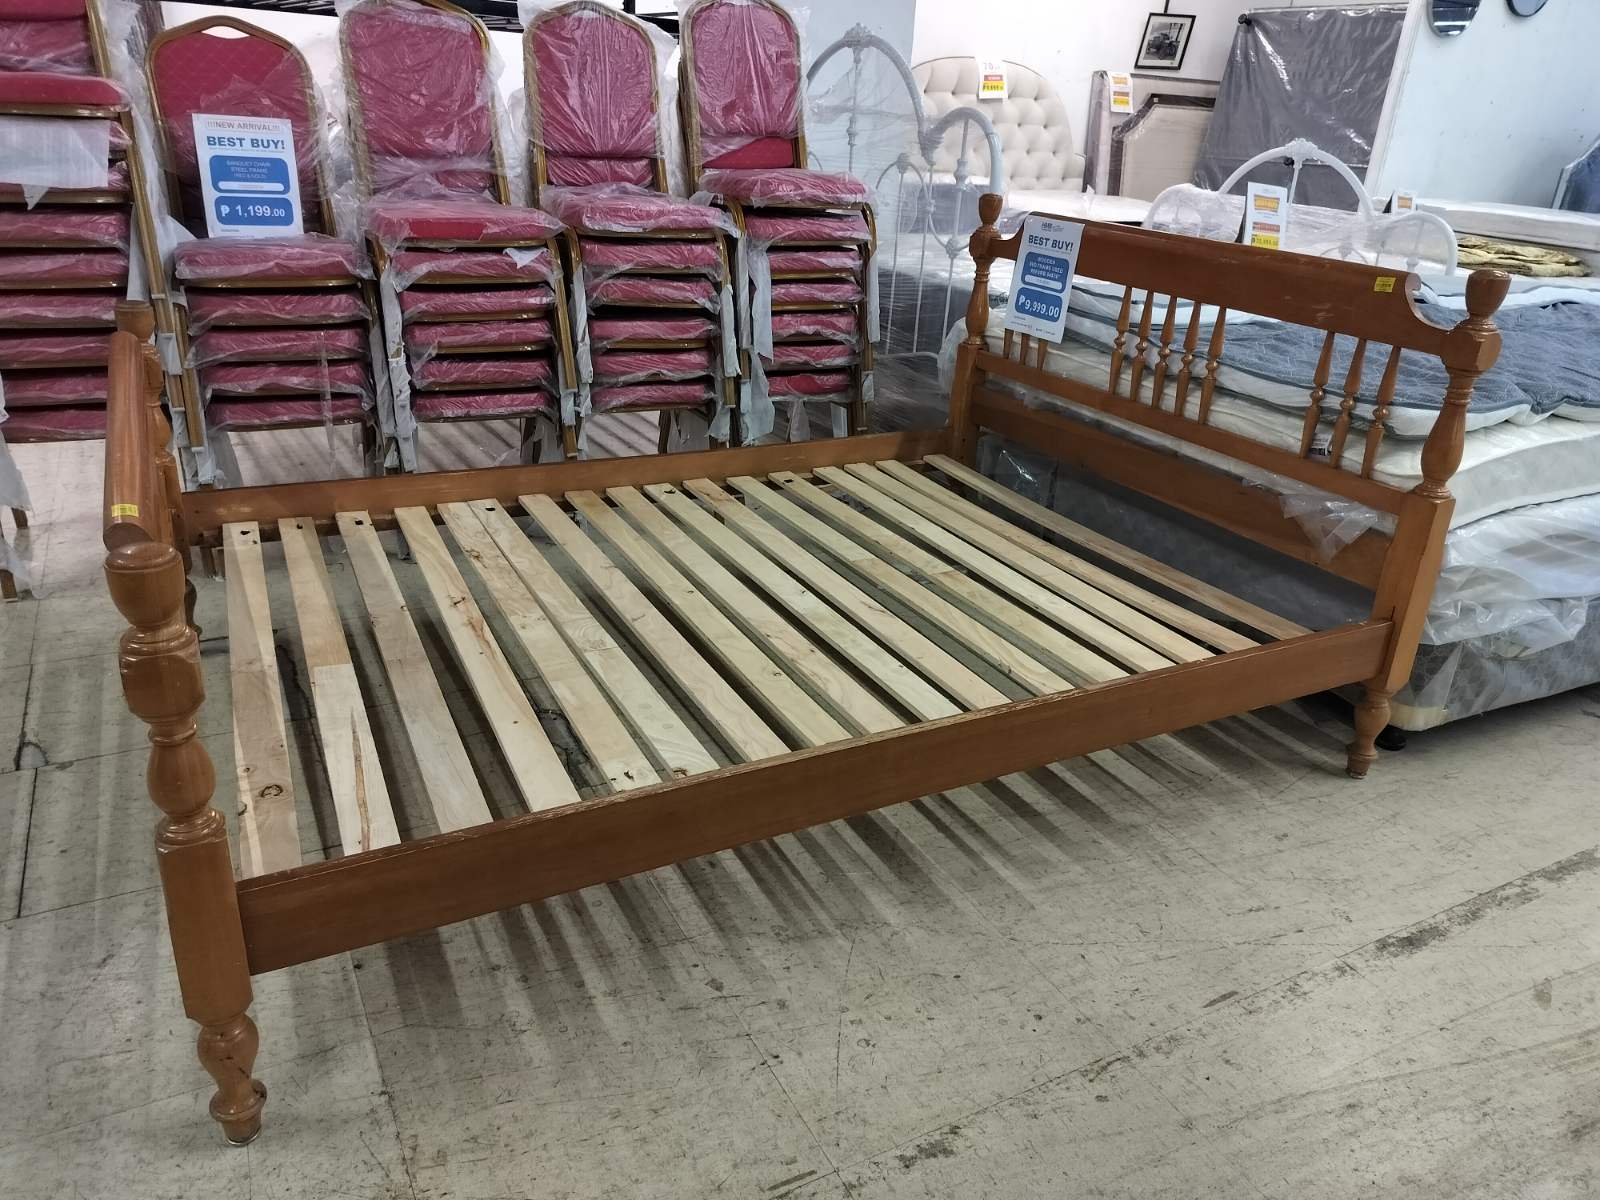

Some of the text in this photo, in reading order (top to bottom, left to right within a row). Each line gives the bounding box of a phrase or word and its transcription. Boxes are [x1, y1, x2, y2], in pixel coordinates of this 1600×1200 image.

[206, 135, 246, 148] BEST
[250, 138, 285, 150] BUY!
[235, 204, 286, 218] 1,199.00
[1028, 234, 1051, 247] BEST
[1051, 239, 1074, 252] BUY!
